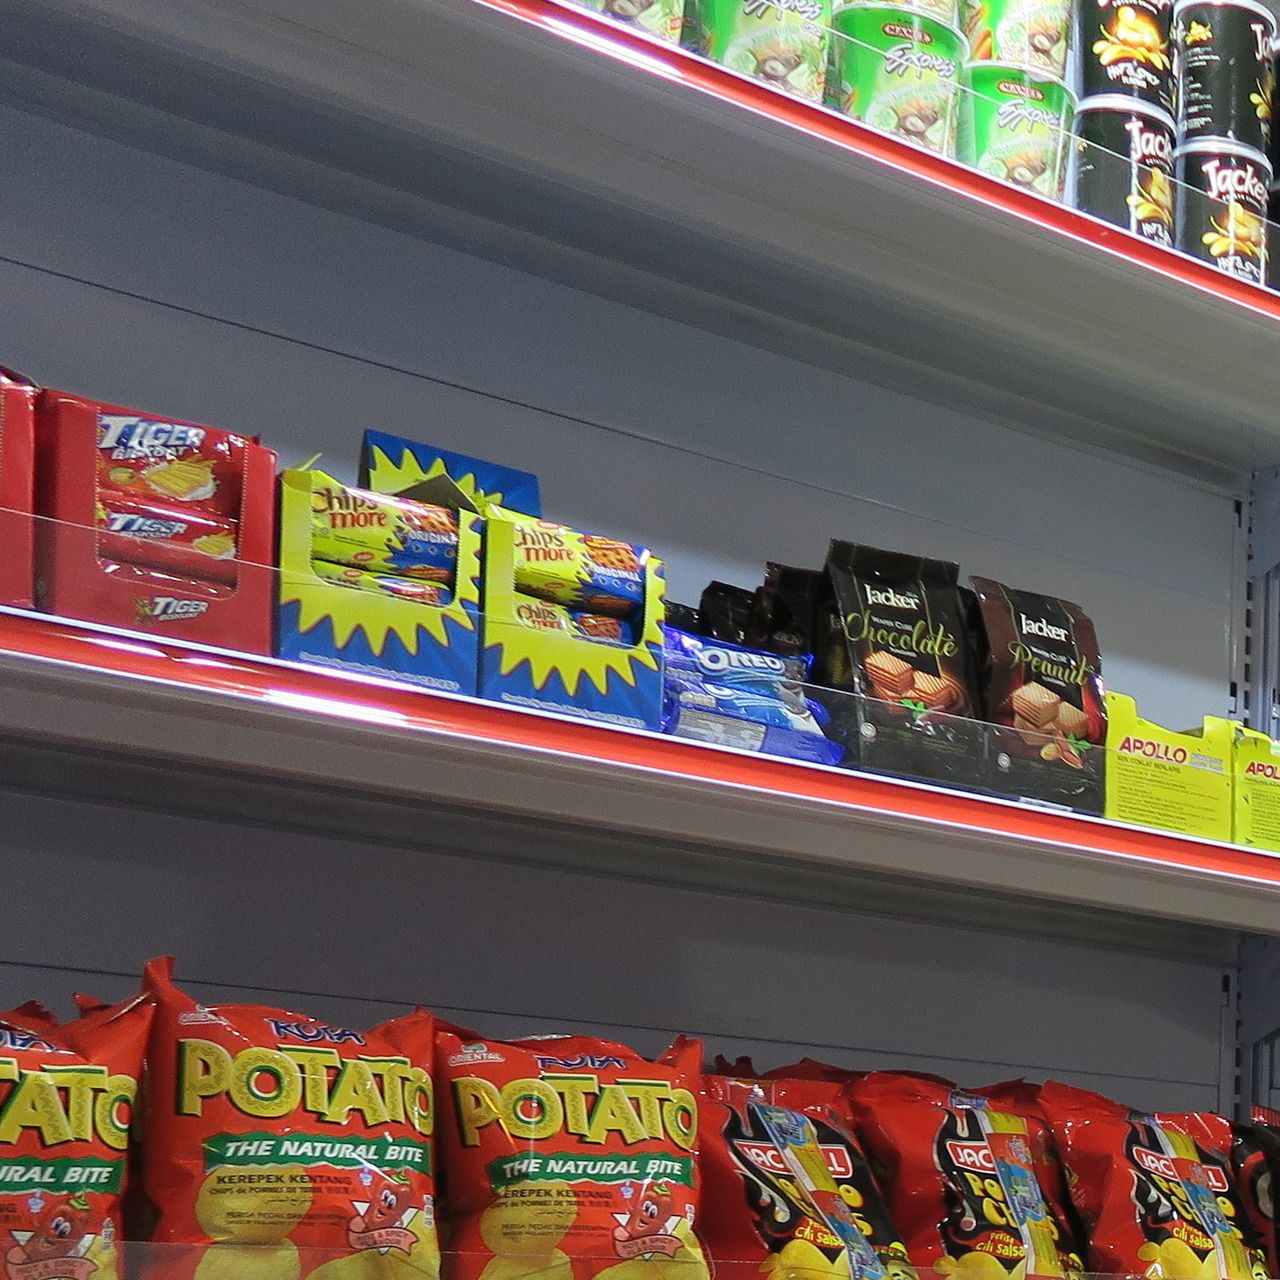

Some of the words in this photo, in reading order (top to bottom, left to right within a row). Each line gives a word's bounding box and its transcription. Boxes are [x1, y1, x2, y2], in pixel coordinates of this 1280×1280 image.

[100, 415, 205, 450] TIGER
[330, 508, 388, 530] more
[525, 545, 575, 563] more
[150, 597, 208, 616] TIGER
[864, 584, 920, 611] Jacker
[845, 611, 959, 659] Chocolate
[1020, 612, 1069, 642] Jacker
[701, 646, 785, 676] OREO
[1007, 641, 1090, 687] Peanut
[1119, 737, 1187, 764] APOLLO
[177, 1038, 434, 1136] POTATO
[450, 1073, 698, 1151] POTATO
[225, 1140, 275, 1157] THE
[280, 1141, 378, 1160] NATURAL
[385, 1145, 424, 1163] BITE
[62, 1167, 113, 1183] BITE
[217, 1174, 285, 1184] KEREPEK
[503, 1158, 541, 1178] THE
[548, 1158, 639, 1176] NATURAL
[646, 1157, 682, 1176] BITE
